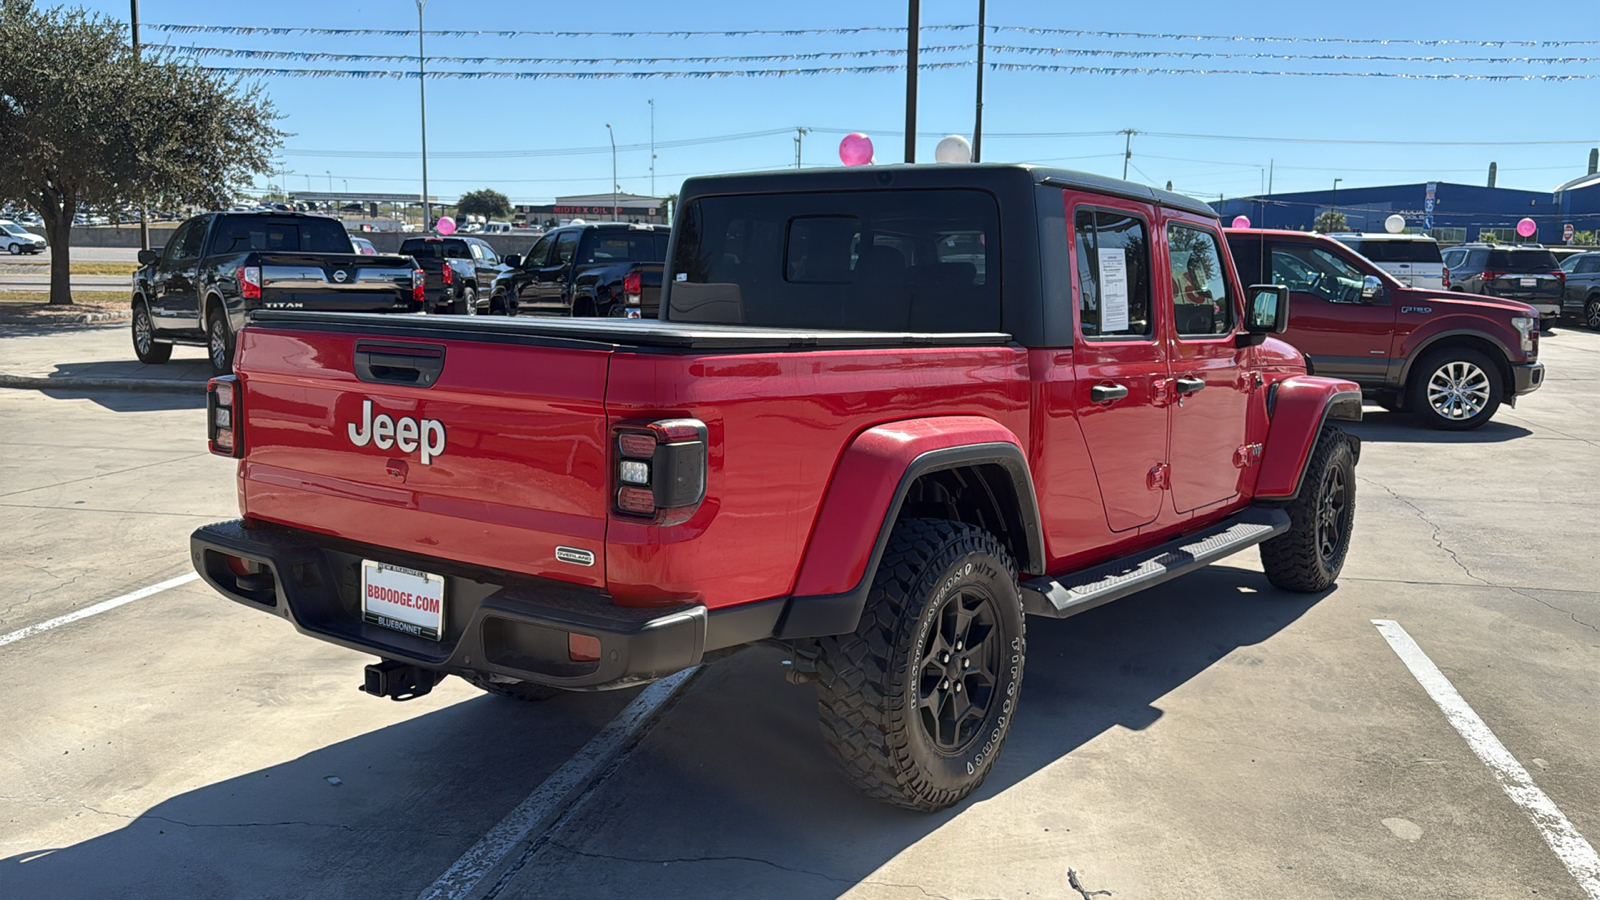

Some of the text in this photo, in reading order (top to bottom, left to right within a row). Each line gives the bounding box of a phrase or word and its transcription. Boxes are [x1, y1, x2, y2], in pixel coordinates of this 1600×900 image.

[553, 206, 589, 214] MIDTEX
[348, 400, 447, 465] Jeep
[367, 584, 440, 613] BBDODGE.COM
[378, 616, 422, 635] BLUEBONNET
